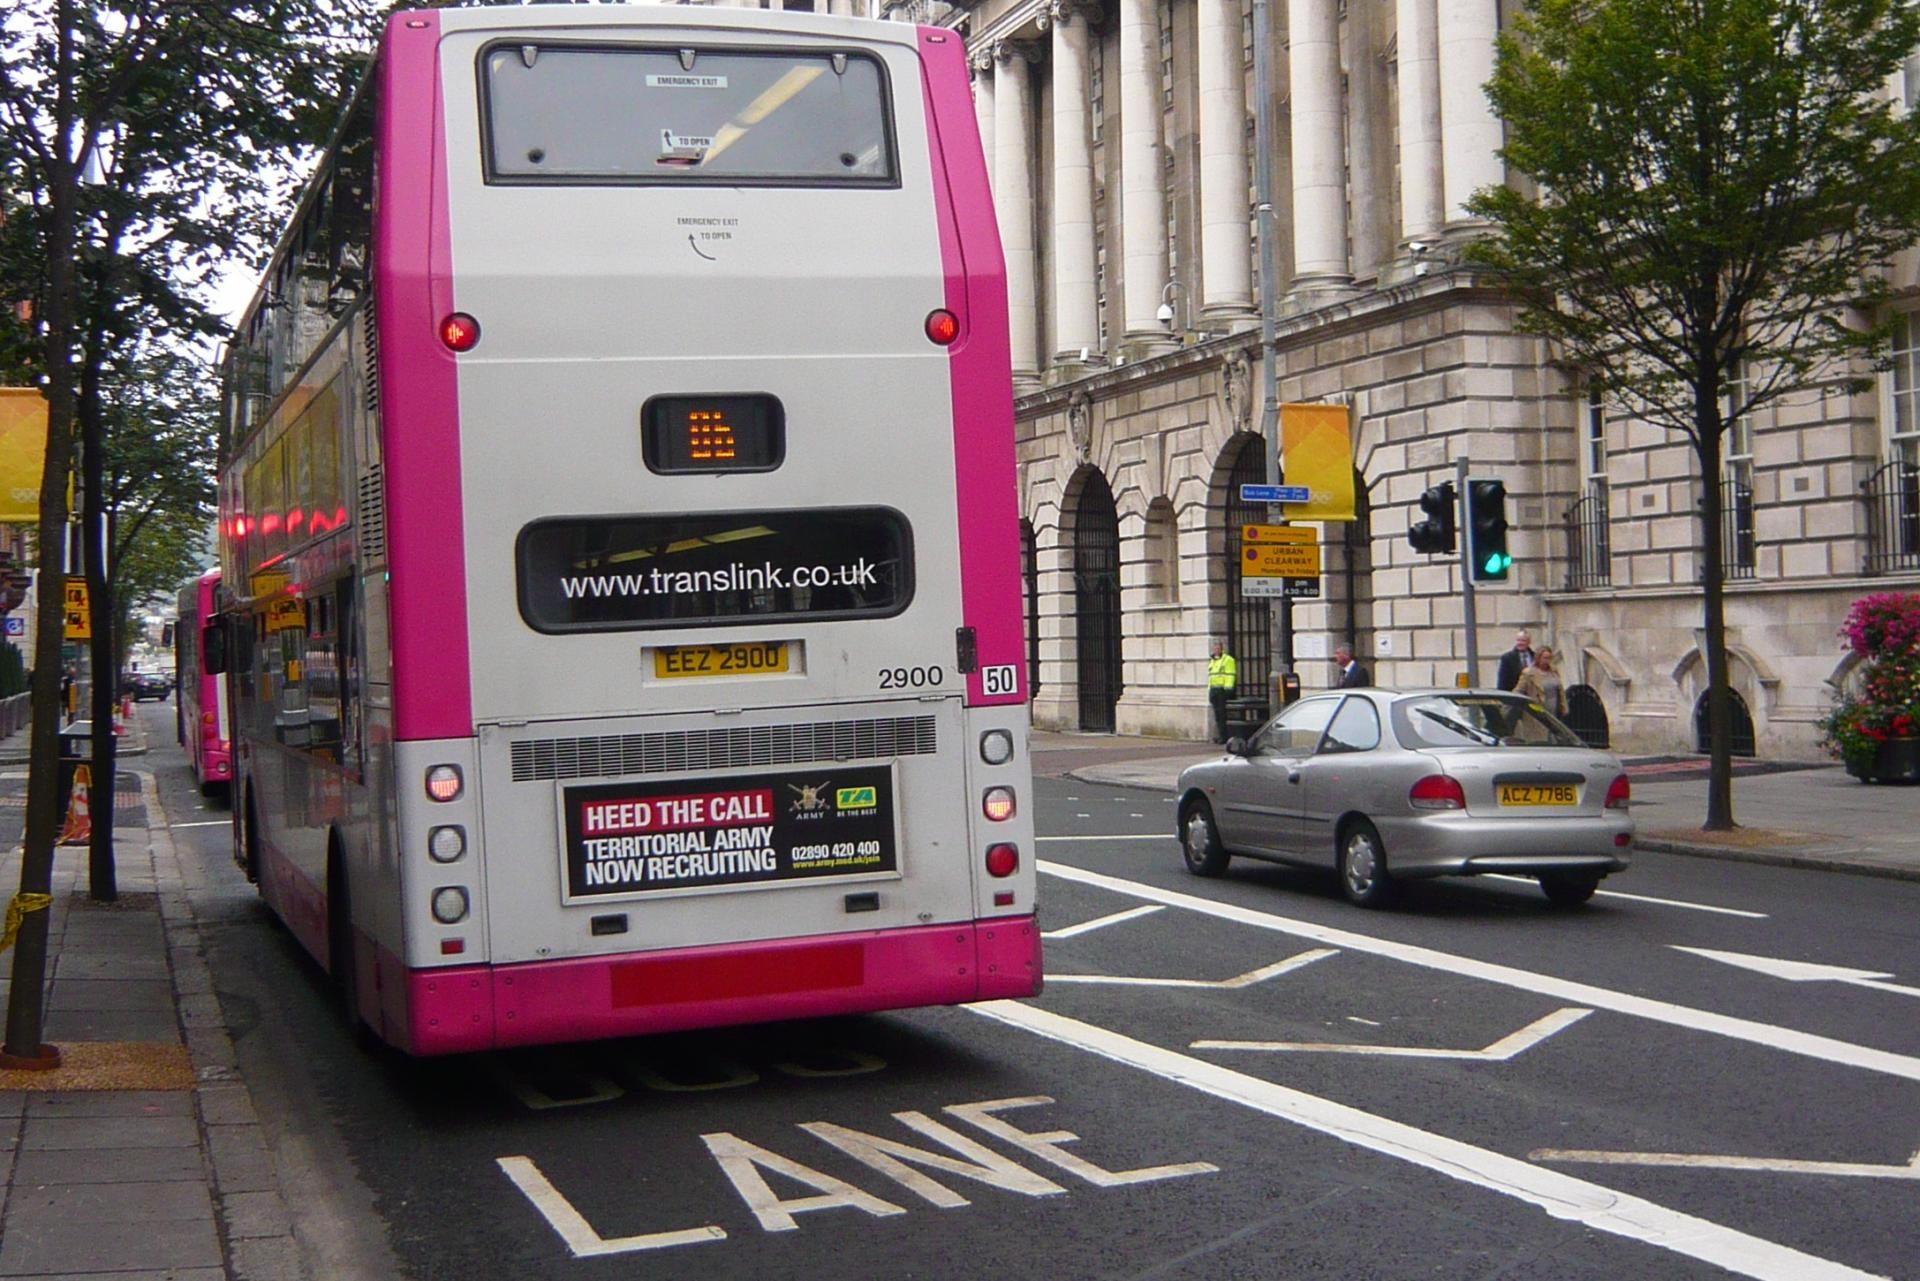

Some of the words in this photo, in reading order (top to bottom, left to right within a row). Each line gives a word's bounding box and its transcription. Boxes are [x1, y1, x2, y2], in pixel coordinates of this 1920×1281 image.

[657, 77, 700, 86] EMERGENCY
[702, 77, 719, 87] EXIT
[679, 137, 690, 146] TO
[690, 138, 711, 146] OPEN
[677, 217, 721, 226] EMERGENCY
[723, 218, 739, 227] EXIT
[700, 232, 711, 241] TO
[712, 232, 732, 241] OPEN
[1272, 547, 1304, 555] URBAN
[1264, 557, 1312, 565] CLEARWAY
[561, 557, 876, 599] www.translink.co.uk
[1260, 567, 1285, 575] Monday
[665, 648, 712, 673] EEZ
[719, 645, 780, 671] 2900
[878, 665, 944, 689] 2900
[986, 667, 1014, 693] 50
[840, 789, 873, 803] TA
[1502, 787, 1532, 803] ACZ
[1533, 787, 1574, 802] 7786
[587, 801, 652, 831] HEED
[657, 798, 705, 826] THE
[711, 793, 770, 822] CALL
[796, 811, 825, 819] ARMY
[583, 831, 712, 861] TERRITORIAL
[714, 826, 774, 851] ARMY
[791, 844, 829, 861] 02890
[832, 843, 855, 859] 420
[857, 840, 880, 857] 400
[586, 858, 644, 886] NOW
[648, 847, 777, 881] RECRUITING
[496, 1095, 1220, 1258] LANE
